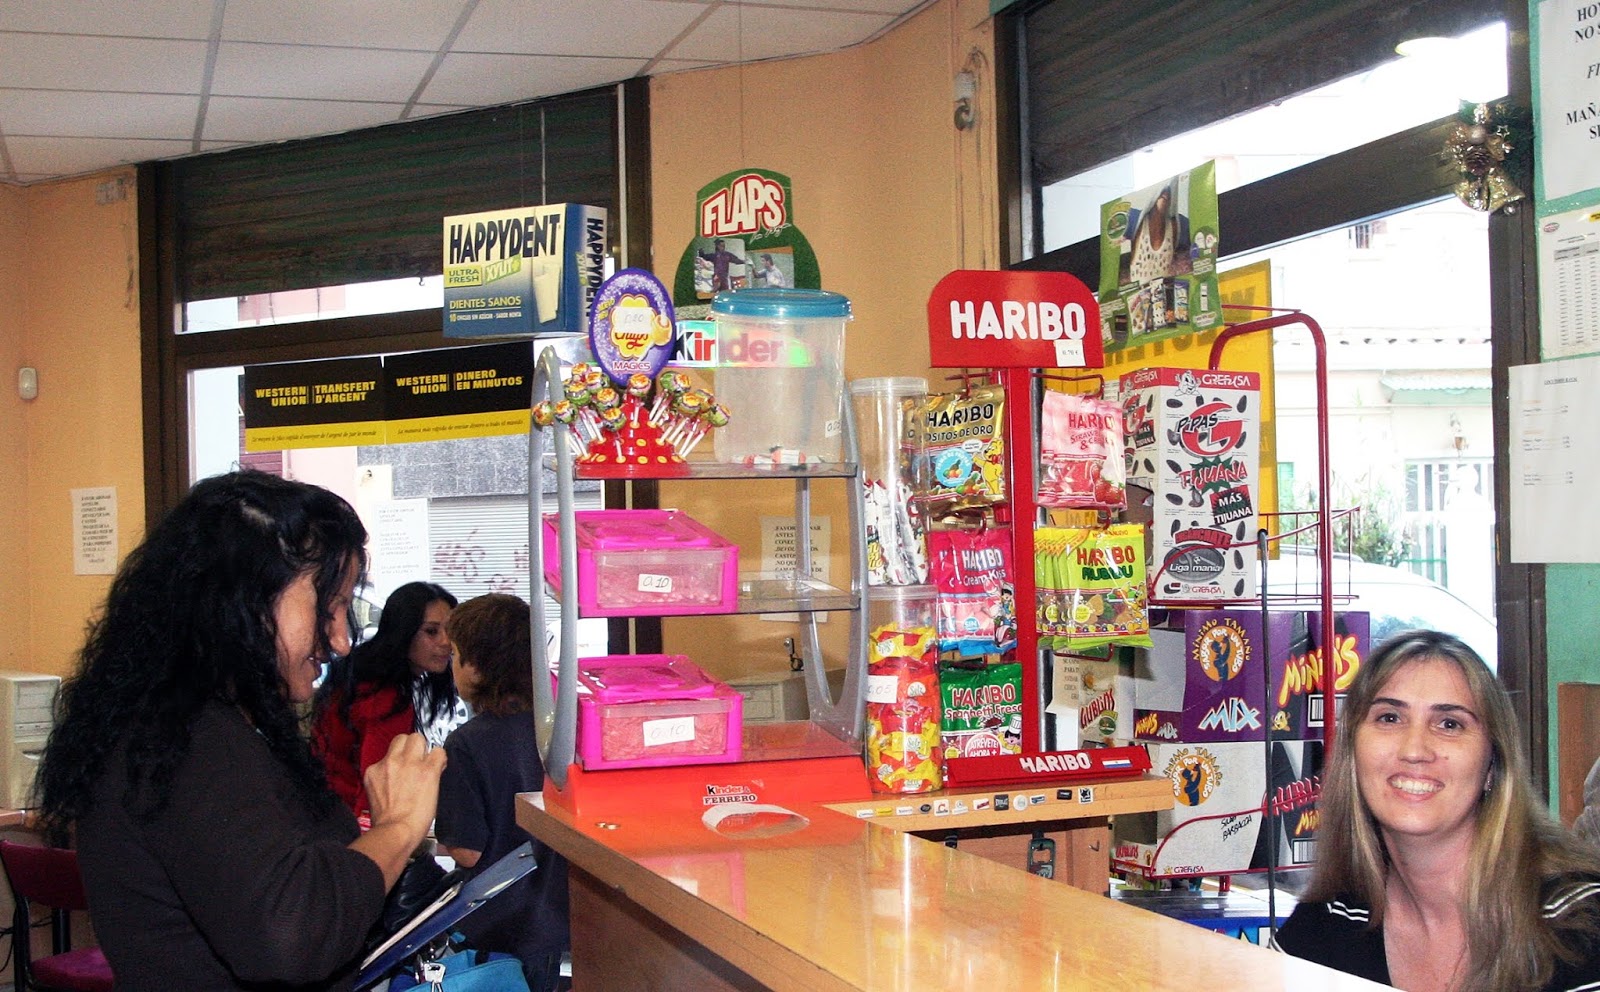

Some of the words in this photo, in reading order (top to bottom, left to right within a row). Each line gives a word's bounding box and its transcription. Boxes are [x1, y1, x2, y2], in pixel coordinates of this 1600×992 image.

[700, 176, 787, 237] FLAPS
[449, 213, 561, 265] HAPPYDENT
[449, 268, 480, 278] ULTRA
[449, 275, 480, 284] FRESH
[449, 299, 487, 310] DIENTES
[488, 296, 522, 307] SANOS
[949, 300, 1087, 341] HARIBO
[396, 373, 447, 388] WESTERN
[456, 369, 497, 382] DINERO
[315, 381, 377, 396] TRANSFERT
[412, 383, 447, 396] UNION
[456, 381, 471, 392] EN
[473, 376, 522, 391] MINUTOS
[255, 385, 306, 399] WESTERN
[315, 391, 367, 404] D'ARGENT
[271, 395, 306, 407] UNION
[926, 403, 994, 427] HARIBO
[959, 428, 971, 438] DE
[972, 424, 994, 436] ORO
[1179, 460, 1249, 490] TIJUANA
[1218, 492, 1243, 507] MÁS
[1214, 506, 1252, 524] TIJUANA
[1169, 563, 1190, 573] Liga
[951, 684, 1016, 707] HARIBO
[945, 703, 994, 721] Spaghetti
[1197, 698, 1262, 733] MIX
[1018, 752, 1092, 774] HARIBO
[704, 795, 757, 804] FERRERO
